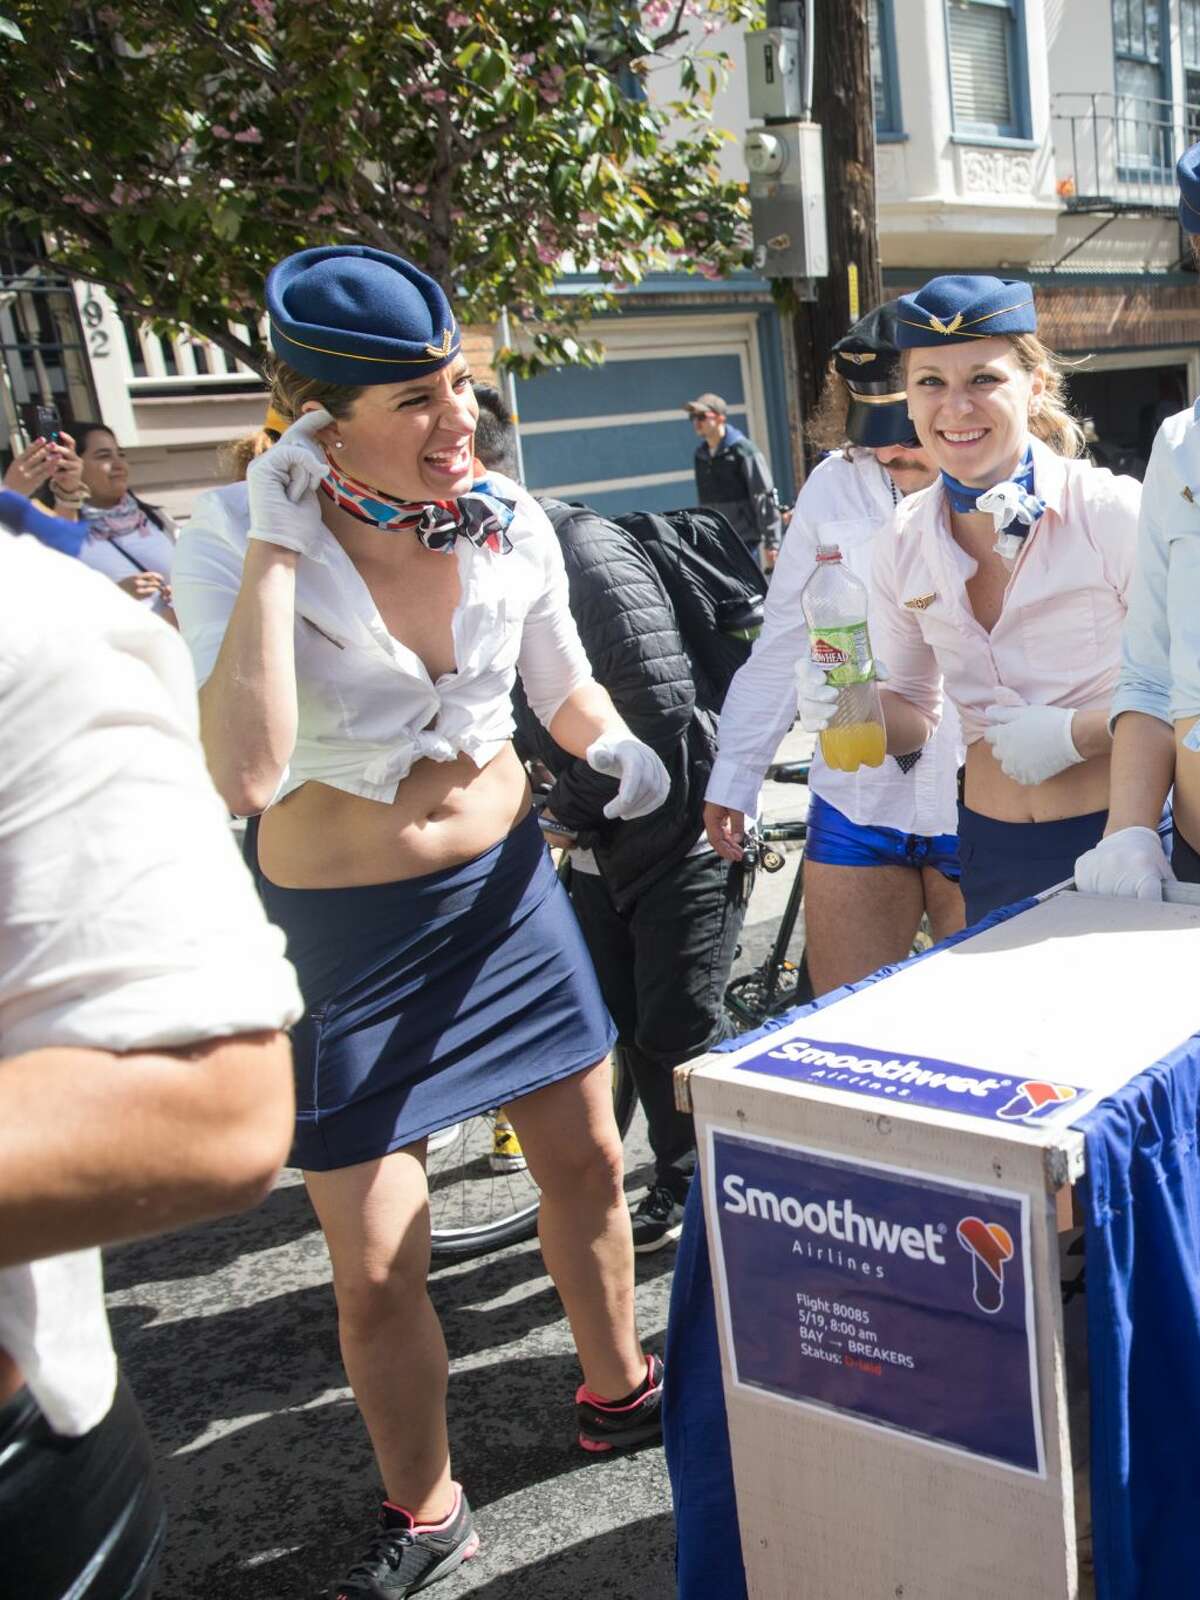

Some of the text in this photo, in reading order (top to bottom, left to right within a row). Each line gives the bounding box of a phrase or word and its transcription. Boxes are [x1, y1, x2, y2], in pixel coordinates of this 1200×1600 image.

[768, 1042, 1001, 1097] Smoothwet
[811, 1070, 912, 1097] Airlines
[722, 1174, 946, 1265] Smoothwet
[791, 1239, 885, 1279] Airlines
[796, 1293, 870, 1324] Flight 80085
[798, 1309, 878, 1342] 5/19, 8:00 am
[799, 1326, 824, 1343] BAY
[847, 1340, 915, 1369] BREAKERS
[800, 1342, 843, 1364] Status:
